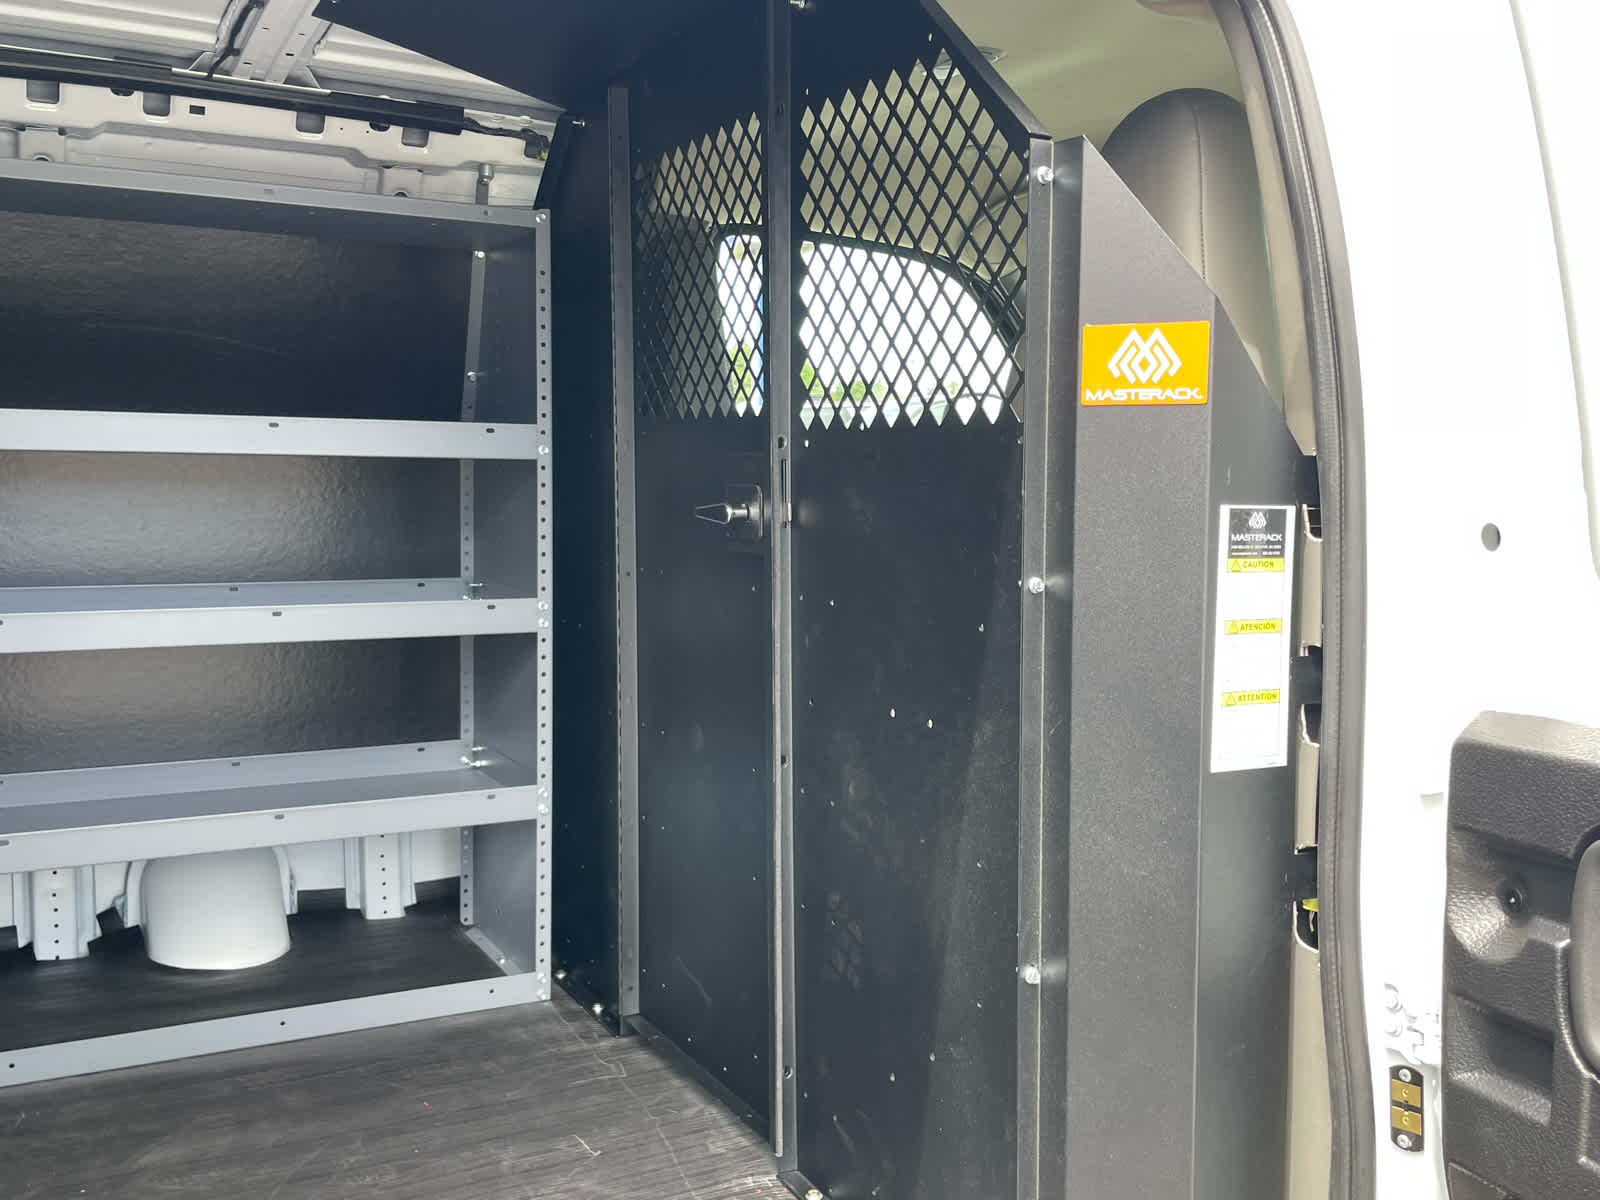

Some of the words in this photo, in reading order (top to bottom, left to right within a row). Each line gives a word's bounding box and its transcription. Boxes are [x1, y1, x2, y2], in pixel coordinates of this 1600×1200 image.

[1085, 387, 1201, 401] MASTERACK
[1231, 534, 1282, 542] MASTERACK
[1242, 560, 1274, 569] CAUTION
[1240, 622, 1276, 631] ATENCIÓN
[1238, 693, 1277, 702] ATTENTION
